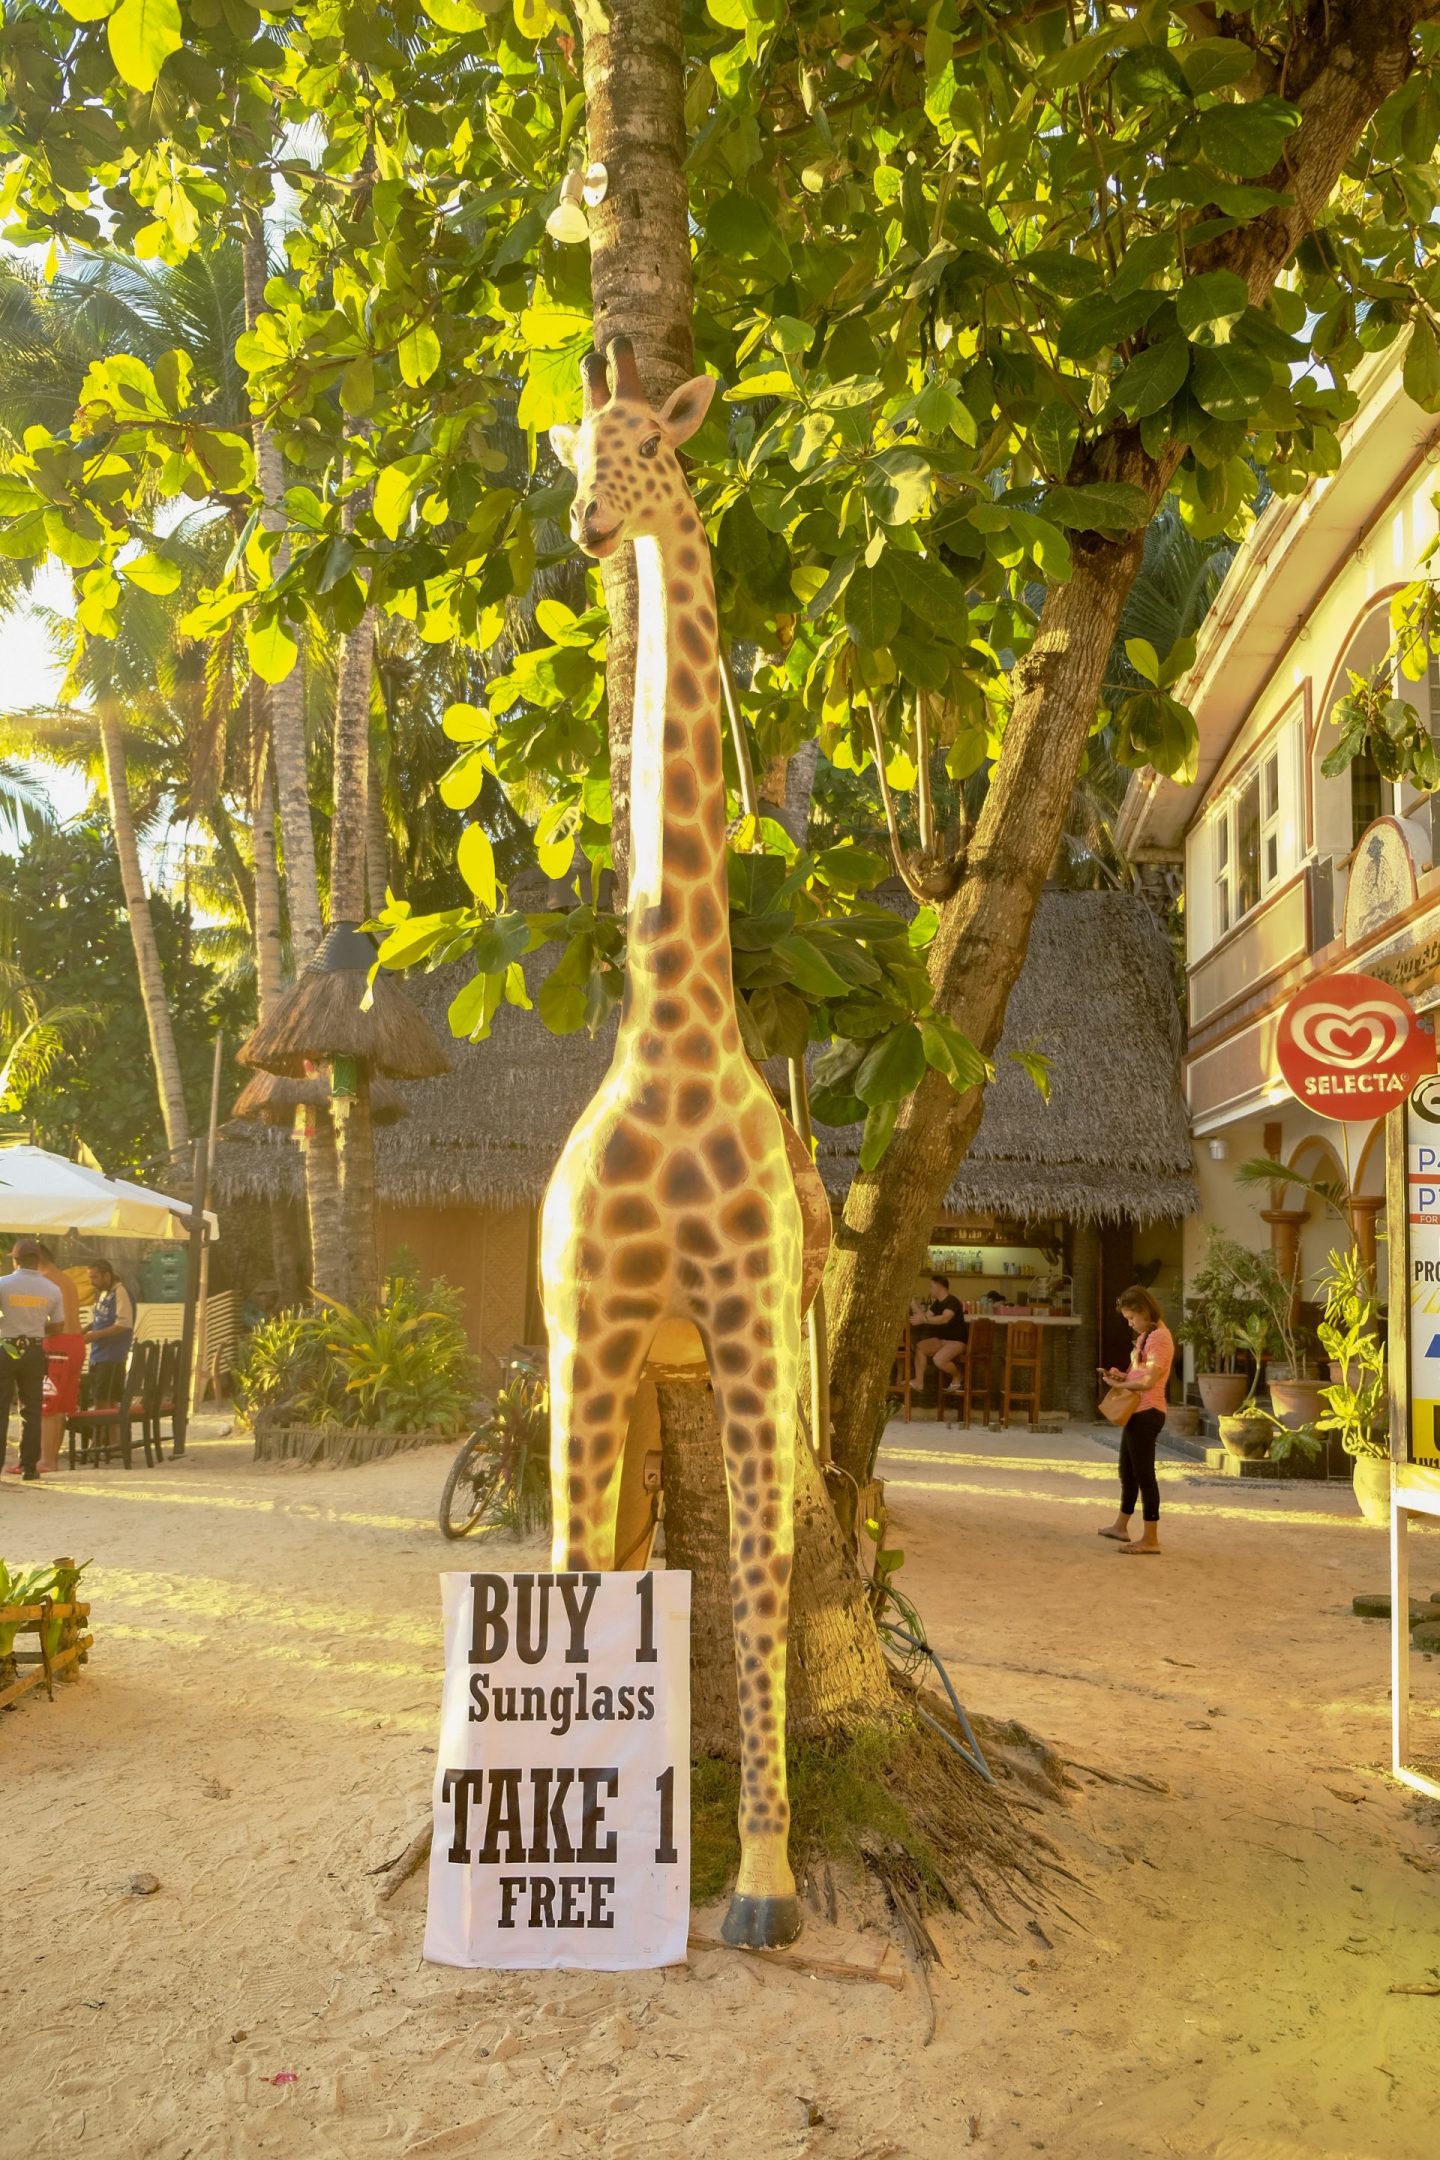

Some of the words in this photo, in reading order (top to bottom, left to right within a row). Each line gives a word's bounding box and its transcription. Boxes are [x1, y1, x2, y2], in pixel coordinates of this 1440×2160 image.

[1304, 1073, 1404, 1096] SELECTA
[1418, 1148, 1440, 1172] P
[1418, 1187, 1440, 1212] P
[1419, 1215, 1438, 1223] FOR
[468, 1573, 601, 1665] BUY
[635, 1571, 658, 1663] 1
[468, 1673, 655, 1736] Sunglass
[442, 1767, 619, 1864] TAKE
[655, 1766, 678, 1864] 1
[498, 1877, 615, 1929] FREE
